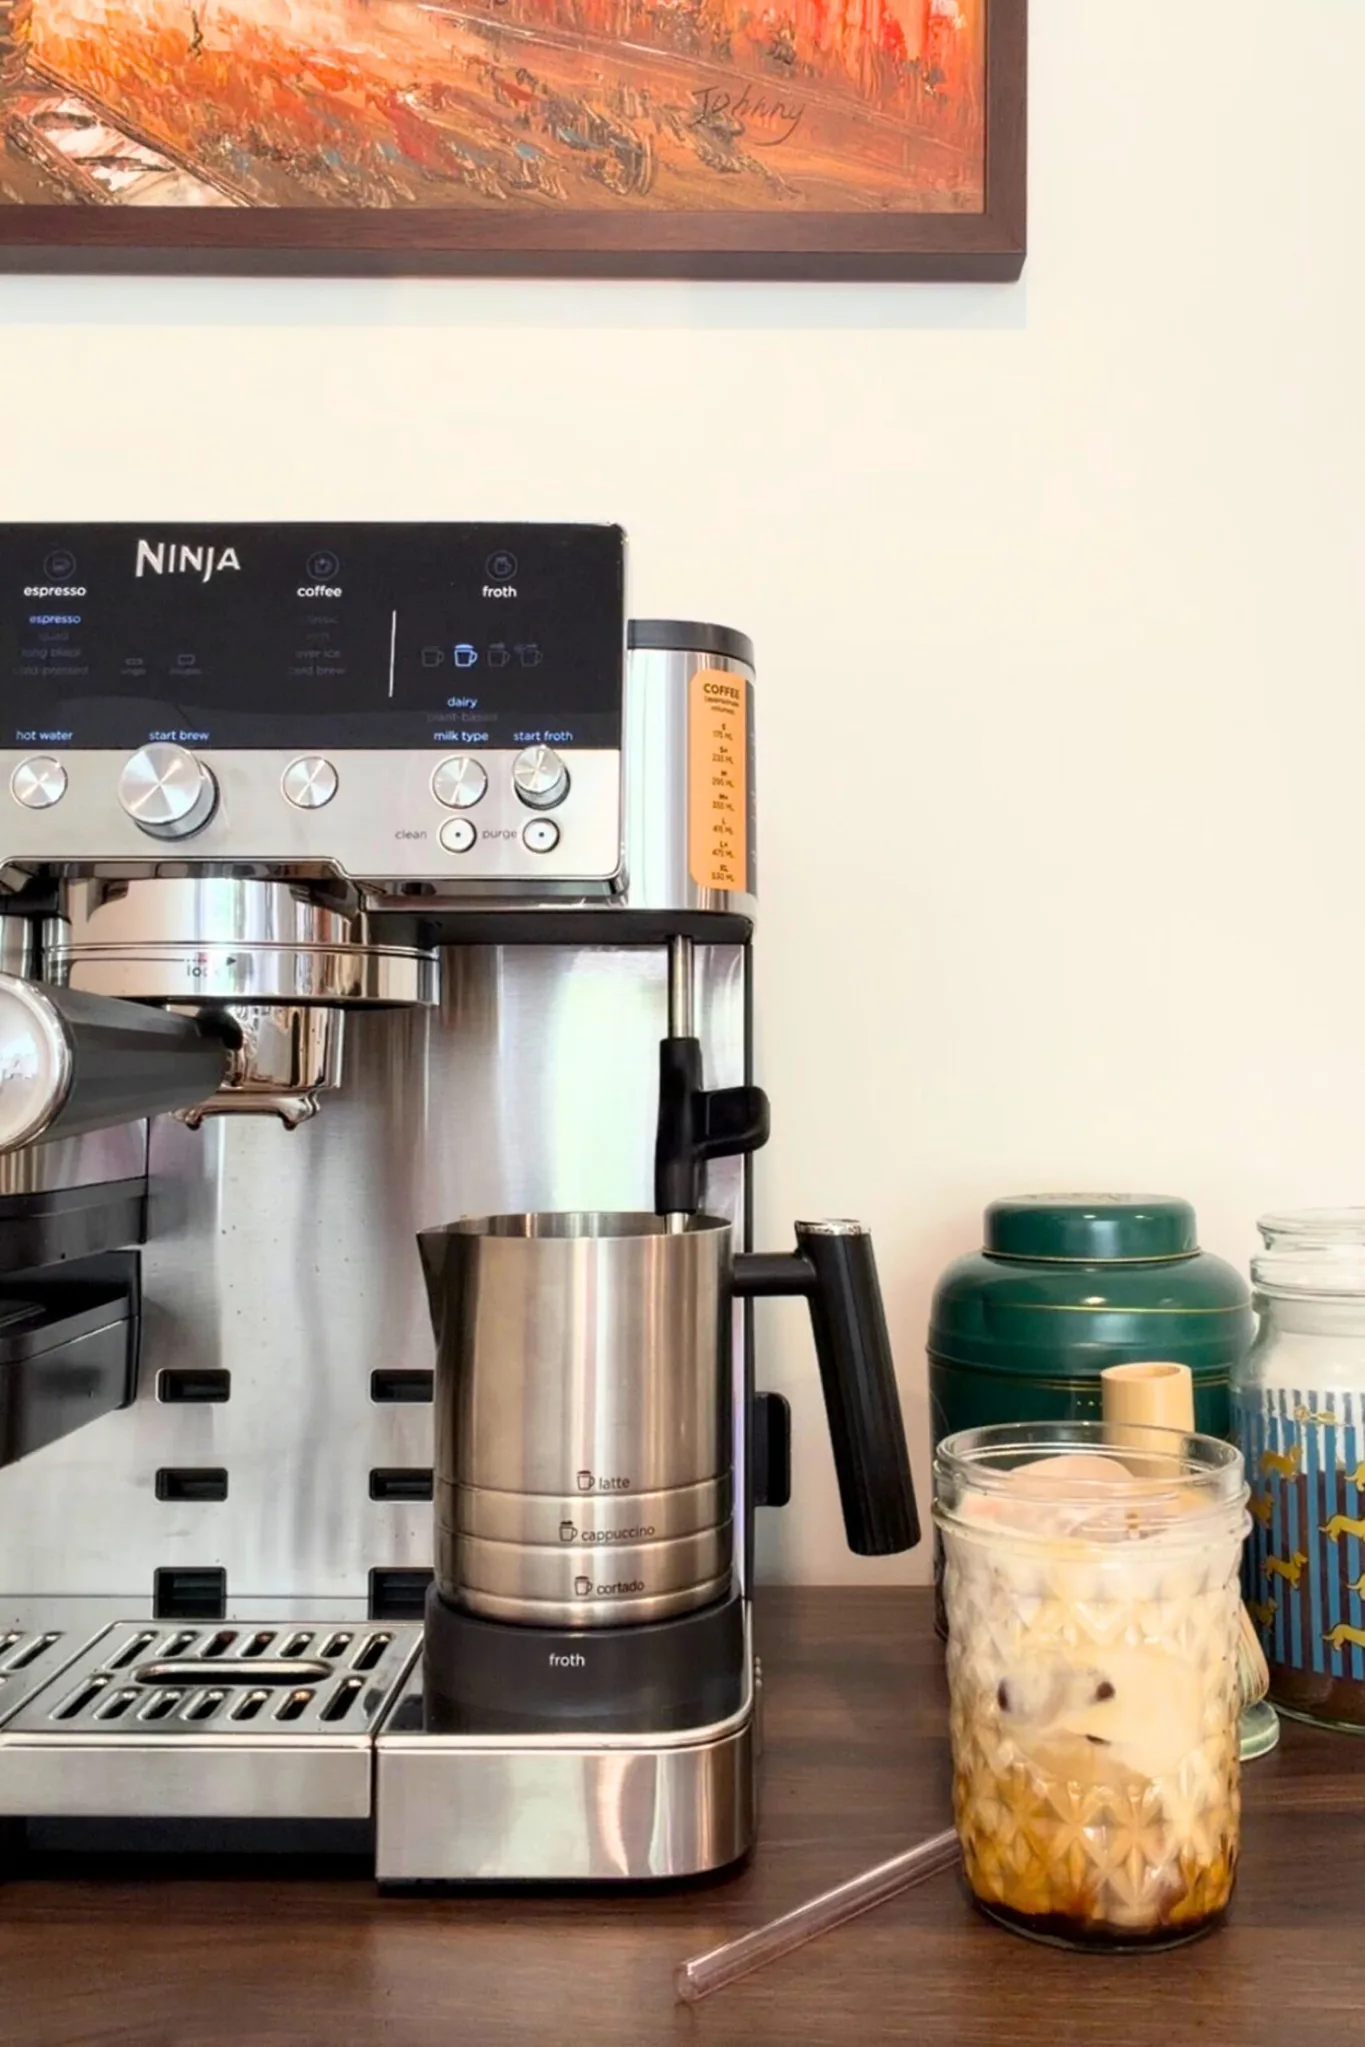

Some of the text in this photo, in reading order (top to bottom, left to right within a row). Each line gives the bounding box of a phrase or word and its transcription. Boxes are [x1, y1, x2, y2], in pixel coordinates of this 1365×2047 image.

[135, 539, 241, 583] NINJA
[23, 586, 87, 598] espresso
[297, 586, 342, 597] coffee
[482, 585, 517, 598] froth
[29, 614, 81, 625] espresso
[703, 683, 740, 700] COFFEE
[447, 696, 478, 710] dairy
[16, 729, 73, 741] hot water
[149, 730, 210, 741] start brew
[433, 731, 489, 744] milk type
[513, 731, 573, 743] start froth
[395, 829, 427, 840] clean
[482, 827, 517, 840] purge
[599, 1478, 630, 1489] latte
[581, 1525, 655, 1543] cappuccino
[597, 1580, 645, 1595] cortado
[549, 1653, 585, 1667] froth
